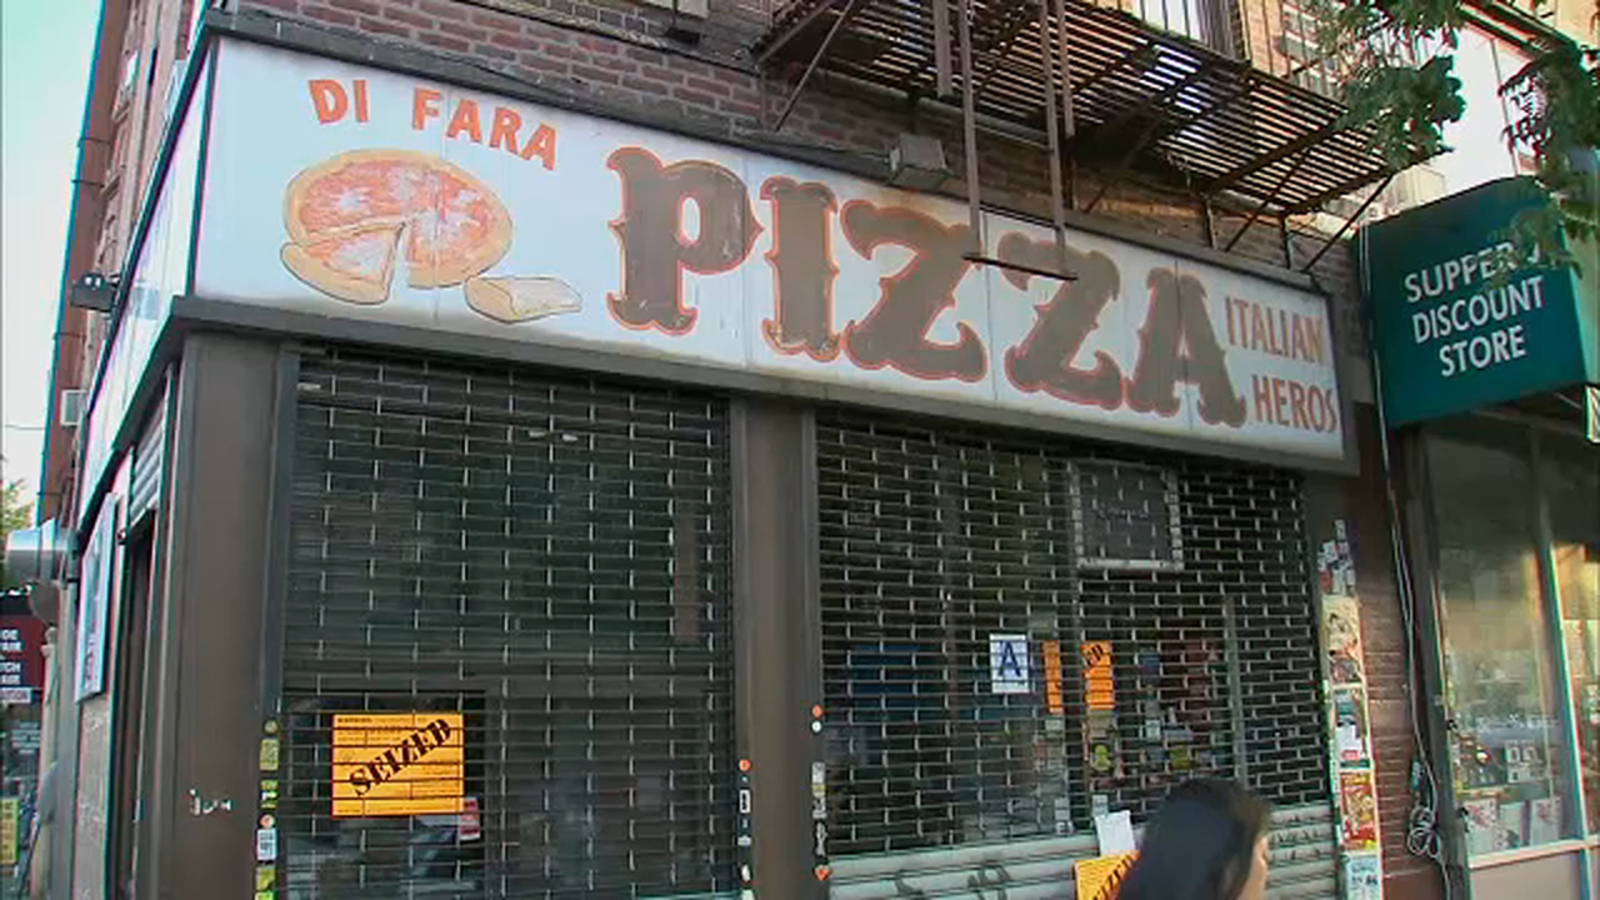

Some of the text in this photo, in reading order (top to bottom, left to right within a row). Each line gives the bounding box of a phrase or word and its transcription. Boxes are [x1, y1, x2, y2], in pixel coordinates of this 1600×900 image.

[309, 79, 558, 171] DI FARA
[606, 146, 1247, 429] PIZZA
[1412, 275, 1544, 344] DISCOUNT
[1225, 296, 1322, 365] ITALIAN
[1439, 325, 1527, 377] STORE
[1252, 374, 1337, 433] HEROS
[998, 640, 1021, 677] A
[349, 718, 451, 797] SEIZED
